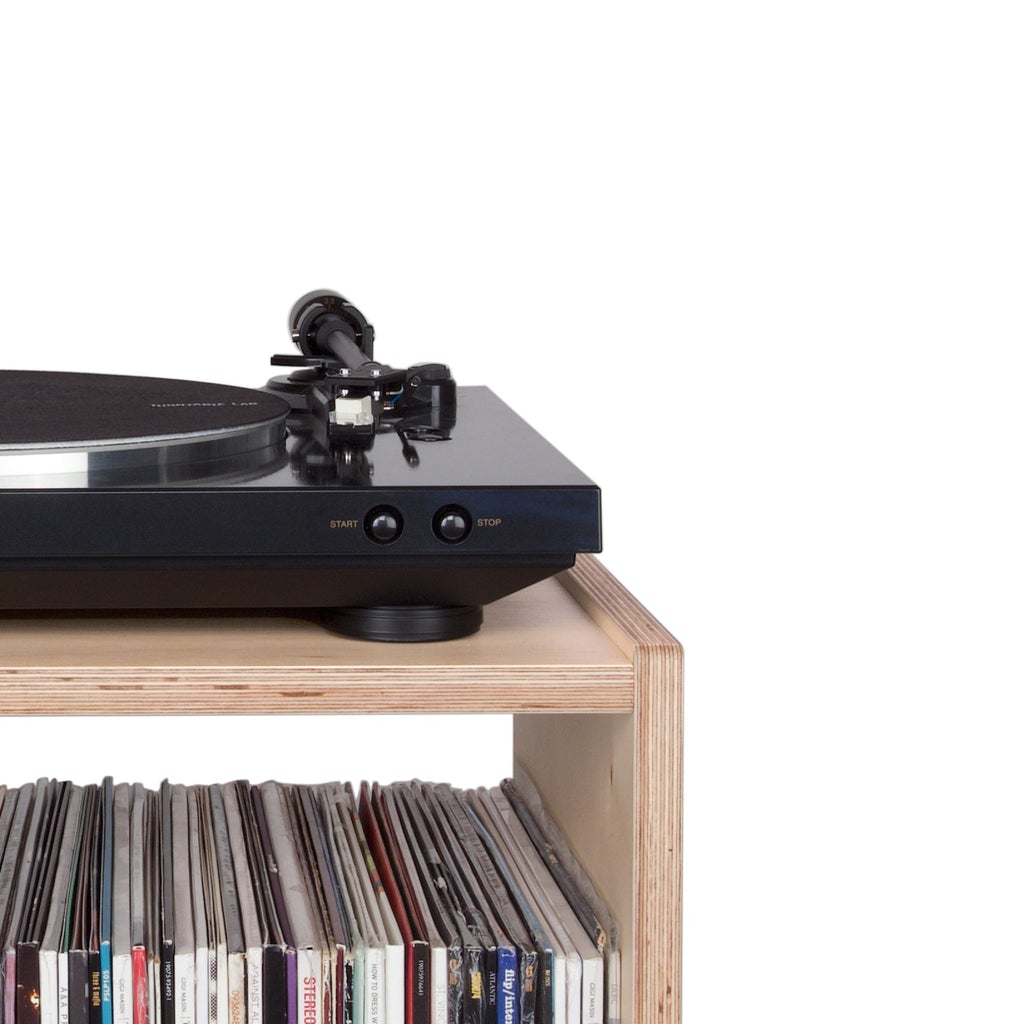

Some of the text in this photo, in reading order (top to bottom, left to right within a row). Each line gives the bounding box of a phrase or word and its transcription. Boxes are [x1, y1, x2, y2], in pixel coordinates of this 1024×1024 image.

[329, 520, 359, 529] START
[477, 518, 502, 527] STOP
[371, 982, 378, 993] TO
[488, 971, 496, 1005] ATLANTIC
[60, 987, 68, 1008] A&A
